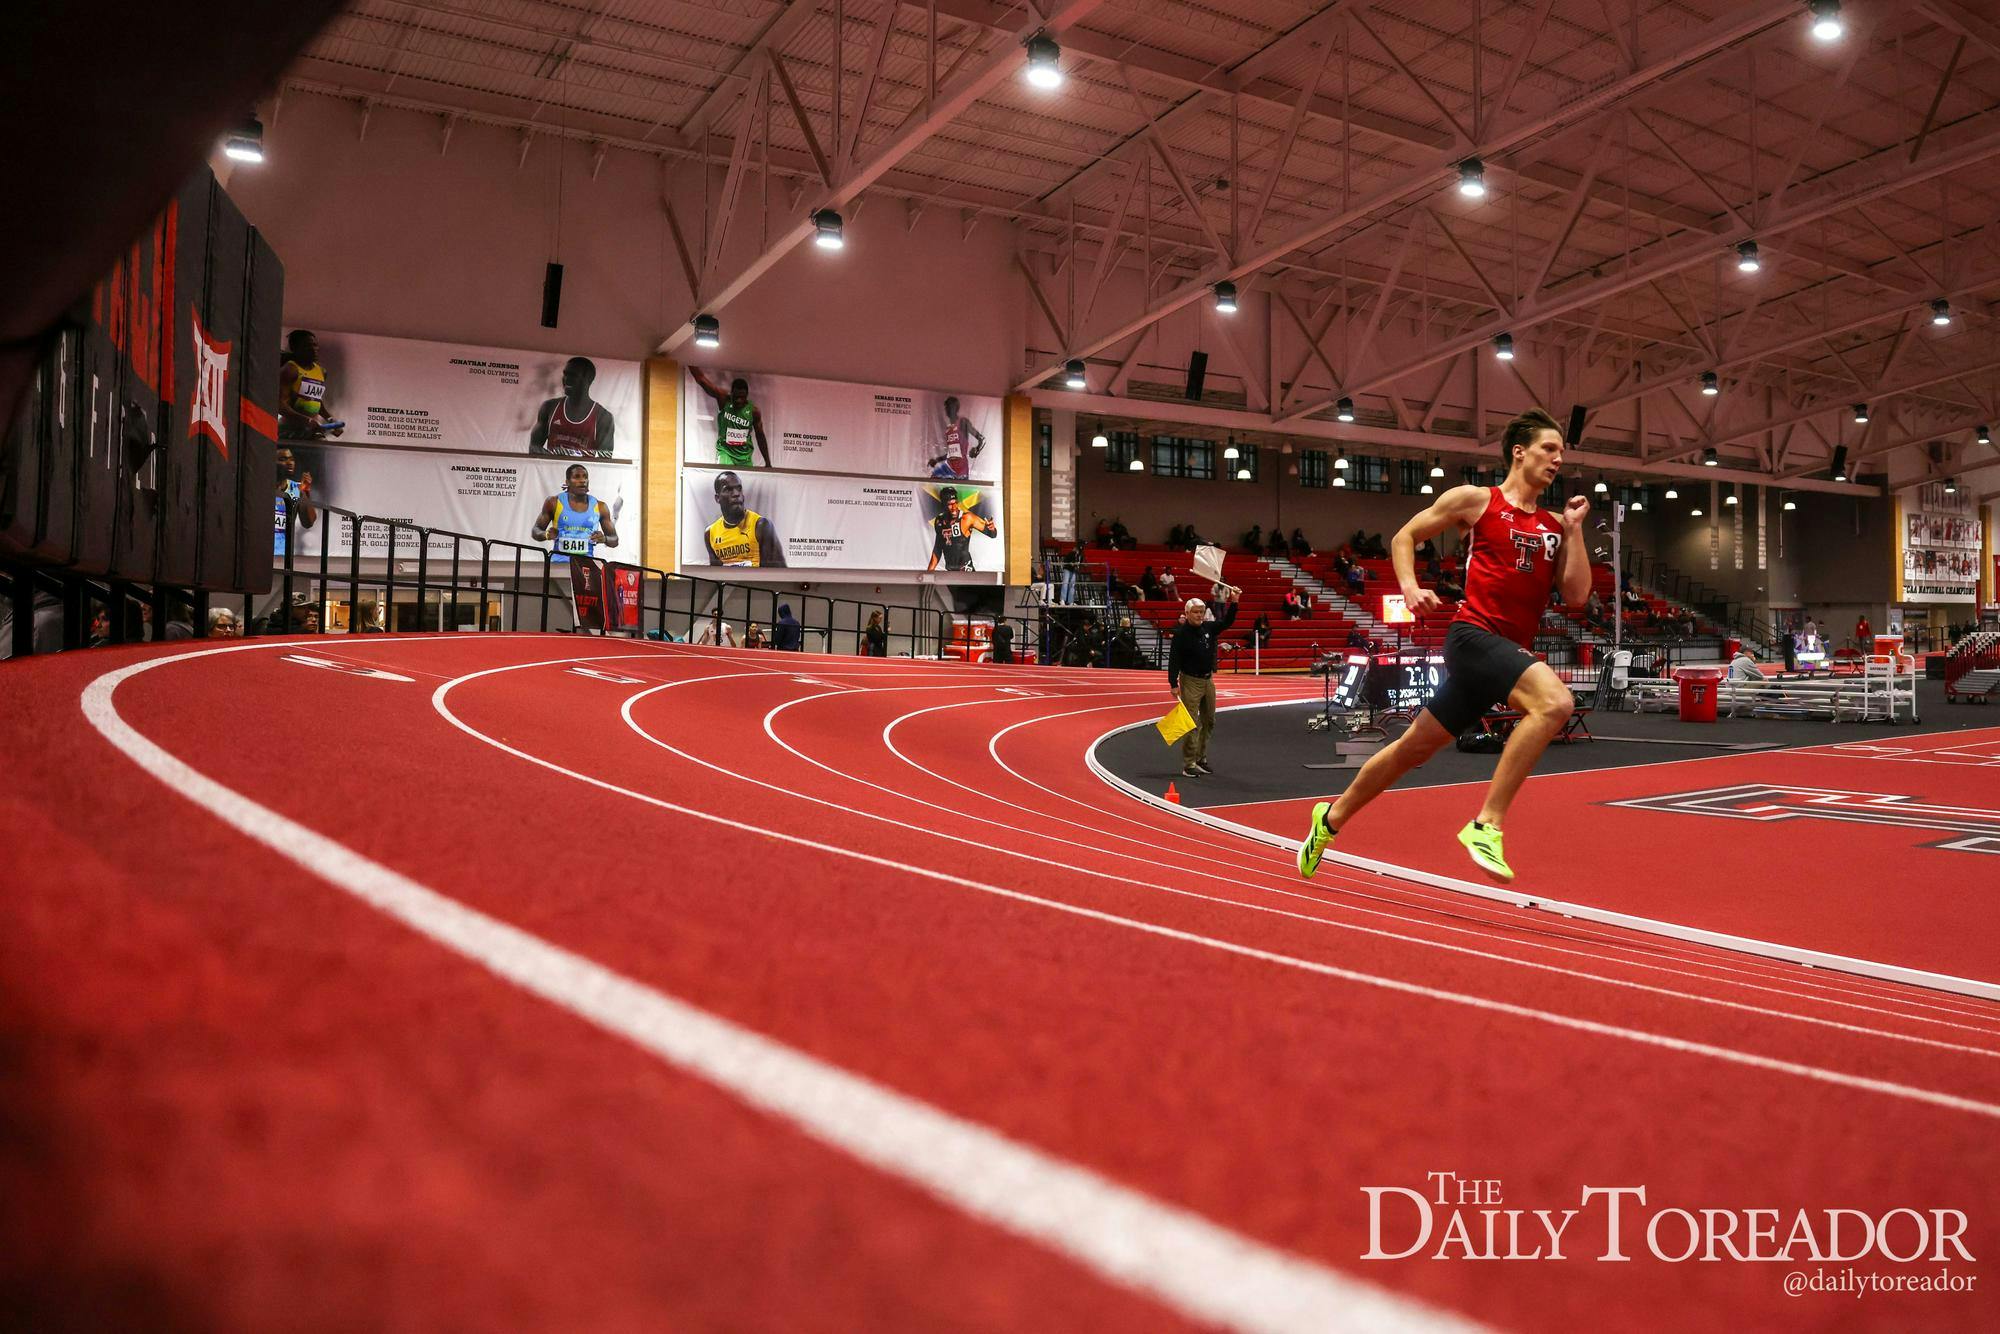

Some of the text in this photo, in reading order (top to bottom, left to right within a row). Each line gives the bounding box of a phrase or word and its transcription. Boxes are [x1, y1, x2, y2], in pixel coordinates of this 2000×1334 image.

[449, 358, 519, 370] JONATHAN JOHNSON
[469, 367, 519, 377] 2004 OLYMPICS
[305, 385, 323, 396] JAM
[367, 407, 405, 415] SHEREEFA
[405, 417, 440, 425] OLYMPICS
[378, 430, 406, 438] BRONZE
[407, 432, 442, 440] MEDALIST
[953, 525, 960, 535] 6
[563, 540, 585, 551] BAH
[1546, 534, 1559, 560] 3
[1918, 586, 1945, 595] NATIONAL
[1945, 587, 1976, 596] CHAMPIONS
